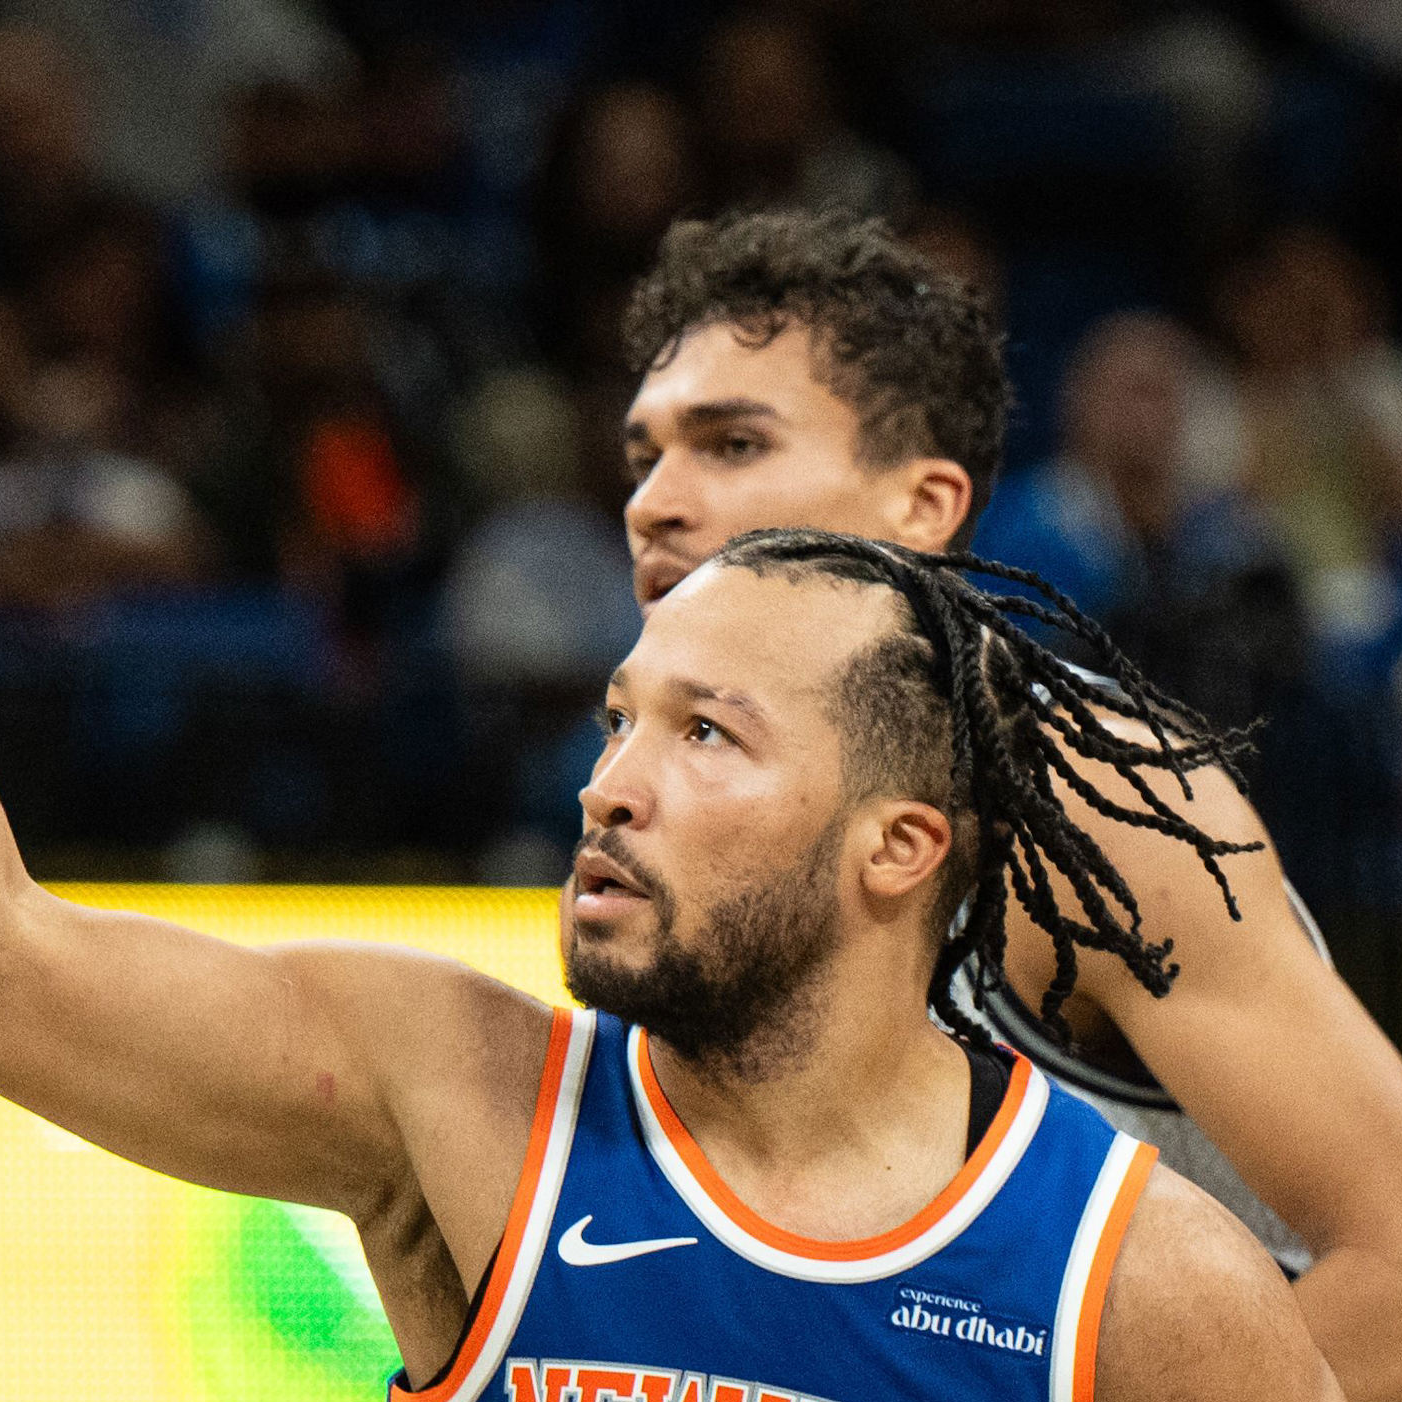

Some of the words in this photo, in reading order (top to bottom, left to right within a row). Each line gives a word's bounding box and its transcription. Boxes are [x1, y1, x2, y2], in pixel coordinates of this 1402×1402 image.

[900, 1287, 981, 1313] experience
[891, 1304, 951, 1337] abu
[955, 1315, 1046, 1356] dhabi
